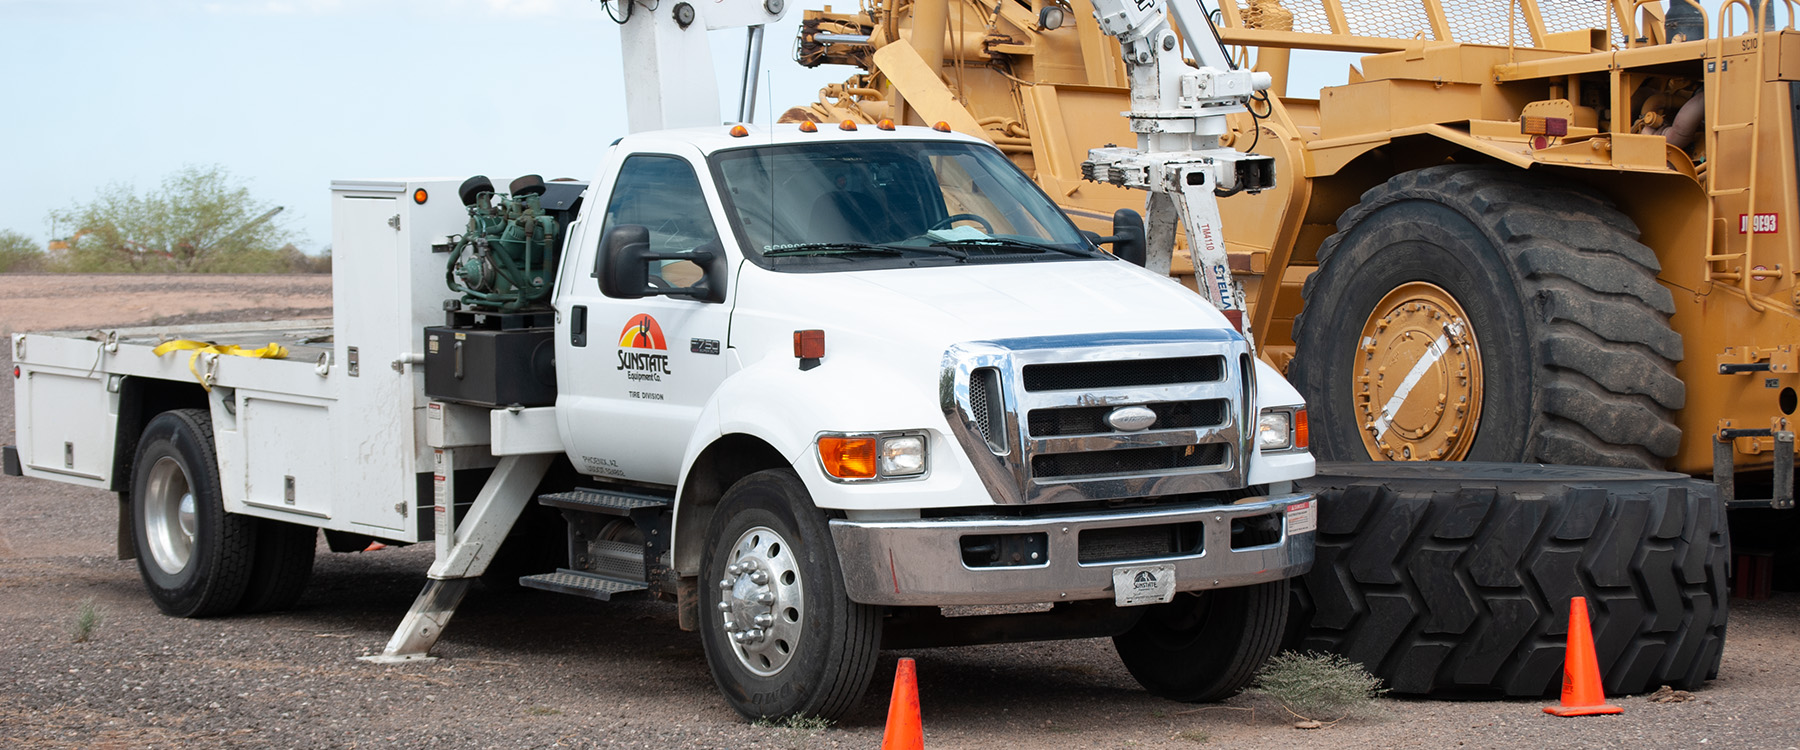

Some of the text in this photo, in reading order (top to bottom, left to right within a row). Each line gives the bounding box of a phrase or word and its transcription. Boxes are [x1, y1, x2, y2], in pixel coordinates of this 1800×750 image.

[1201, 223, 1215, 251] TM4110
[617, 349, 671, 375] SUNSTATE
[627, 371, 654, 382] Equipment
[629, 391, 664, 400] TIRE DIVISION
